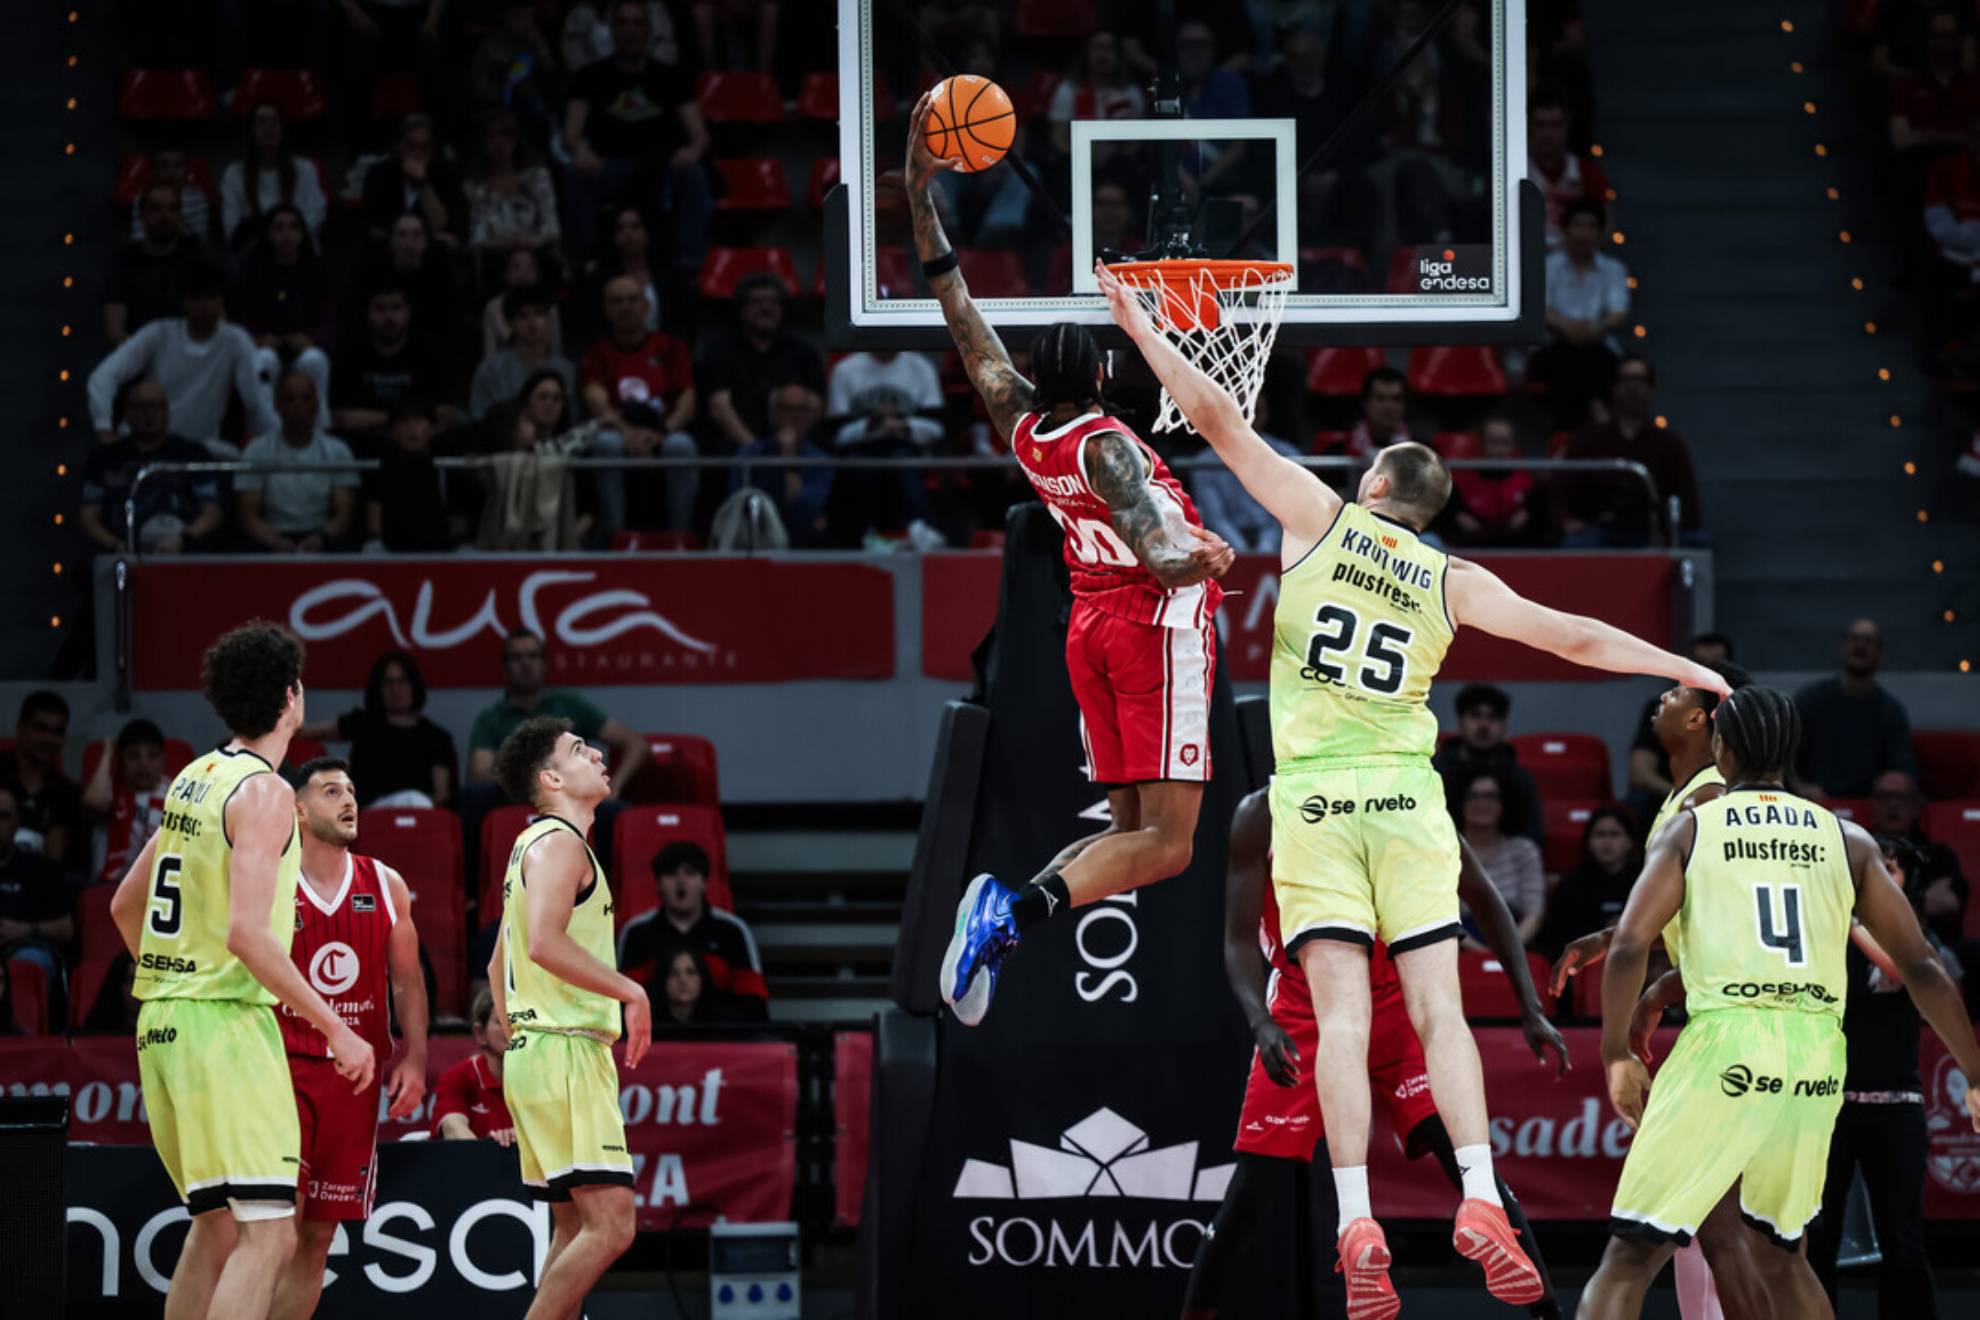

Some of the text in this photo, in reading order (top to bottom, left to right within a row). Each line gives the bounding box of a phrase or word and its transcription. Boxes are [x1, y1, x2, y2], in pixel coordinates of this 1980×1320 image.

[1420, 258, 1453, 278] liga
[1420, 274, 1490, 291] endesa
[289, 569, 718, 656] aura
[1306, 604, 1411, 694] 25
[1725, 804, 1818, 829] AGADA
[150, 856, 182, 934] 5
[1755, 886, 1804, 963] 4
[968, 1216, 1206, 1269] SOMMO
